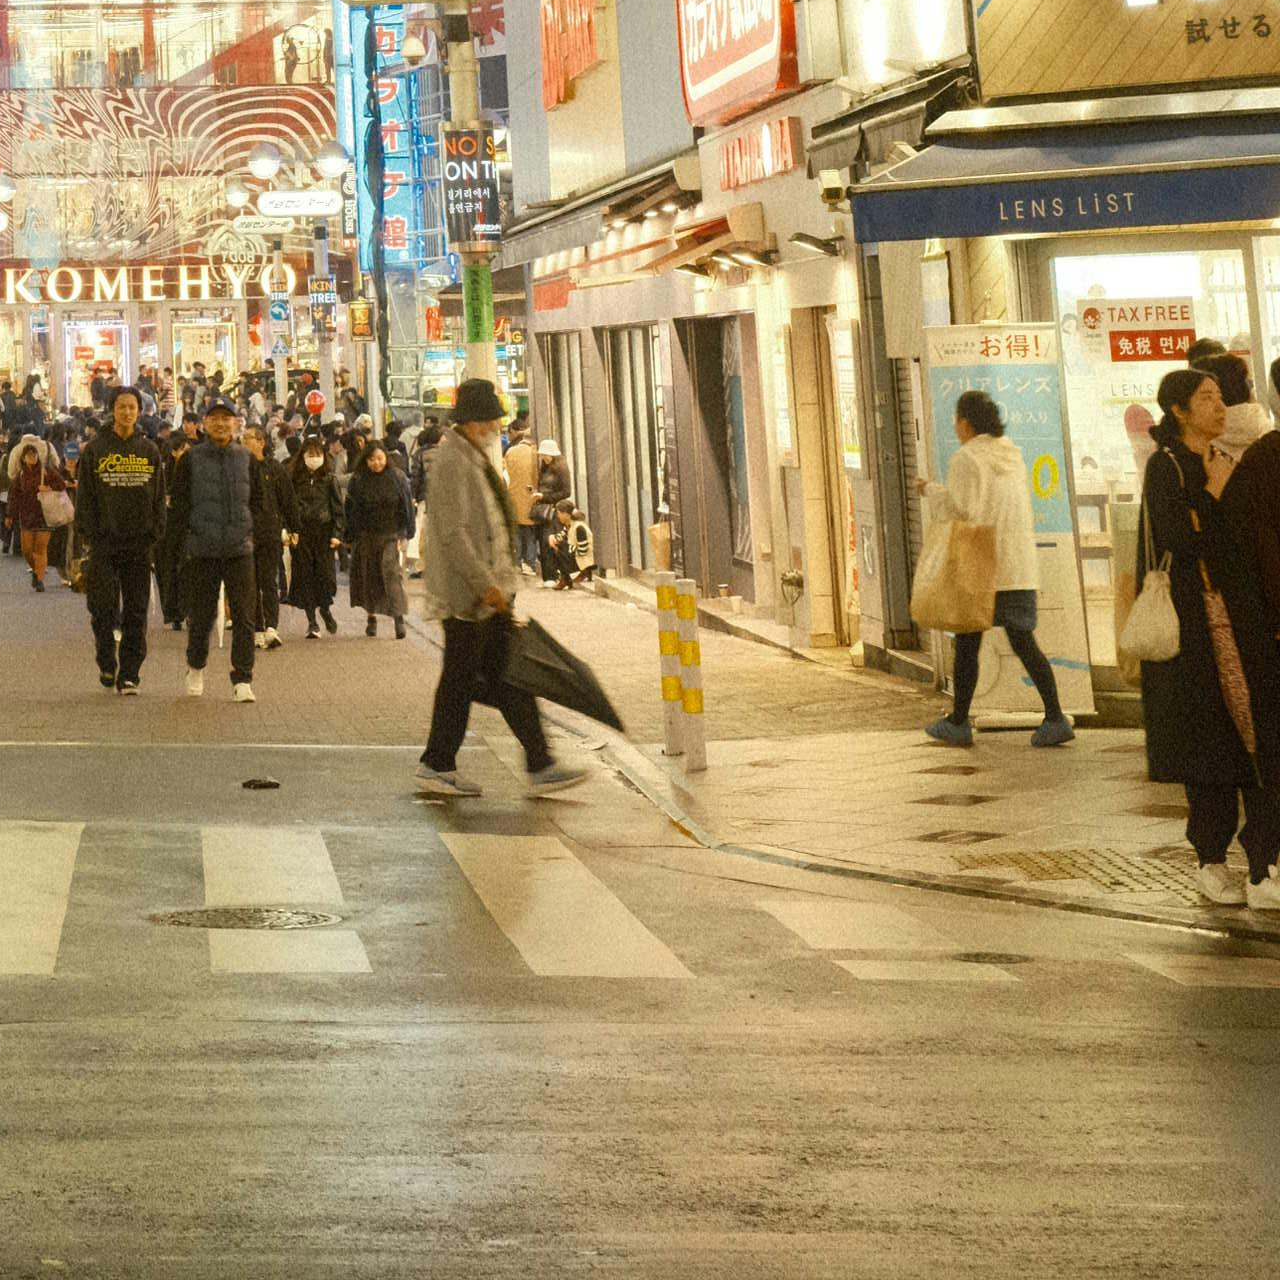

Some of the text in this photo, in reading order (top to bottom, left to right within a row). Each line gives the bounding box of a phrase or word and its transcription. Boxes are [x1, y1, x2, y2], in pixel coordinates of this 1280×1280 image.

[1185, 13, 1272, 44] 試せる
[445, 135, 477, 157] NO
[444, 160, 477, 181] ON
[999, 196, 1064, 222] LENS
[4, 265, 296, 304] KOMEHYO
[1108, 305, 1191, 322] TAX FREE
[980, 334, 1040, 359] お得!
[1119, 336, 1152, 355] 免税
[1159, 335, 1189, 354] 면세
[1111, 383, 1153, 397] LENS
